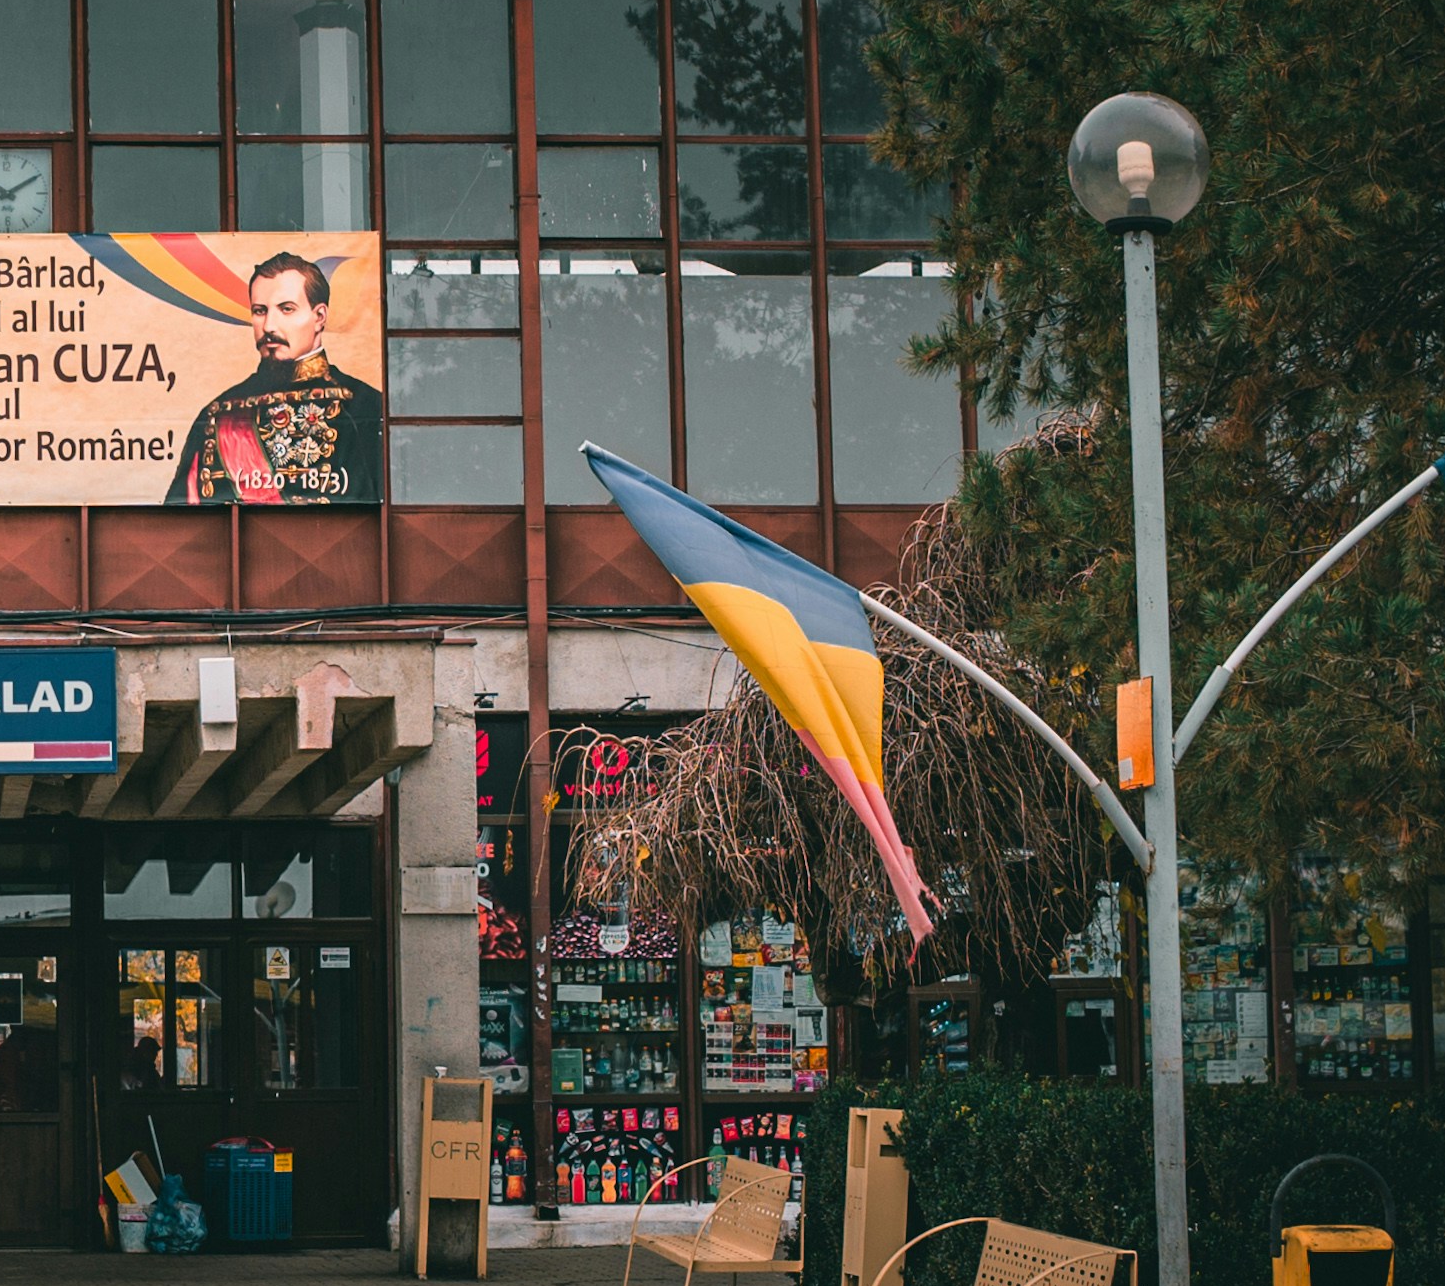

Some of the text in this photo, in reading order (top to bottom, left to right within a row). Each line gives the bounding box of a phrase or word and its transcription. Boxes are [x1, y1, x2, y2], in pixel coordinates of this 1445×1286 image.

[12, 300, 37, 333] al
[49, 300, 85, 332] lui
[53, 344, 177, 391] CUZA,
[39, 430, 175, 463] Române!
[235, 467, 285, 495] (1820
[300, 466, 349, 495] 1873)
[431, 1140, 481, 1161] CFR
